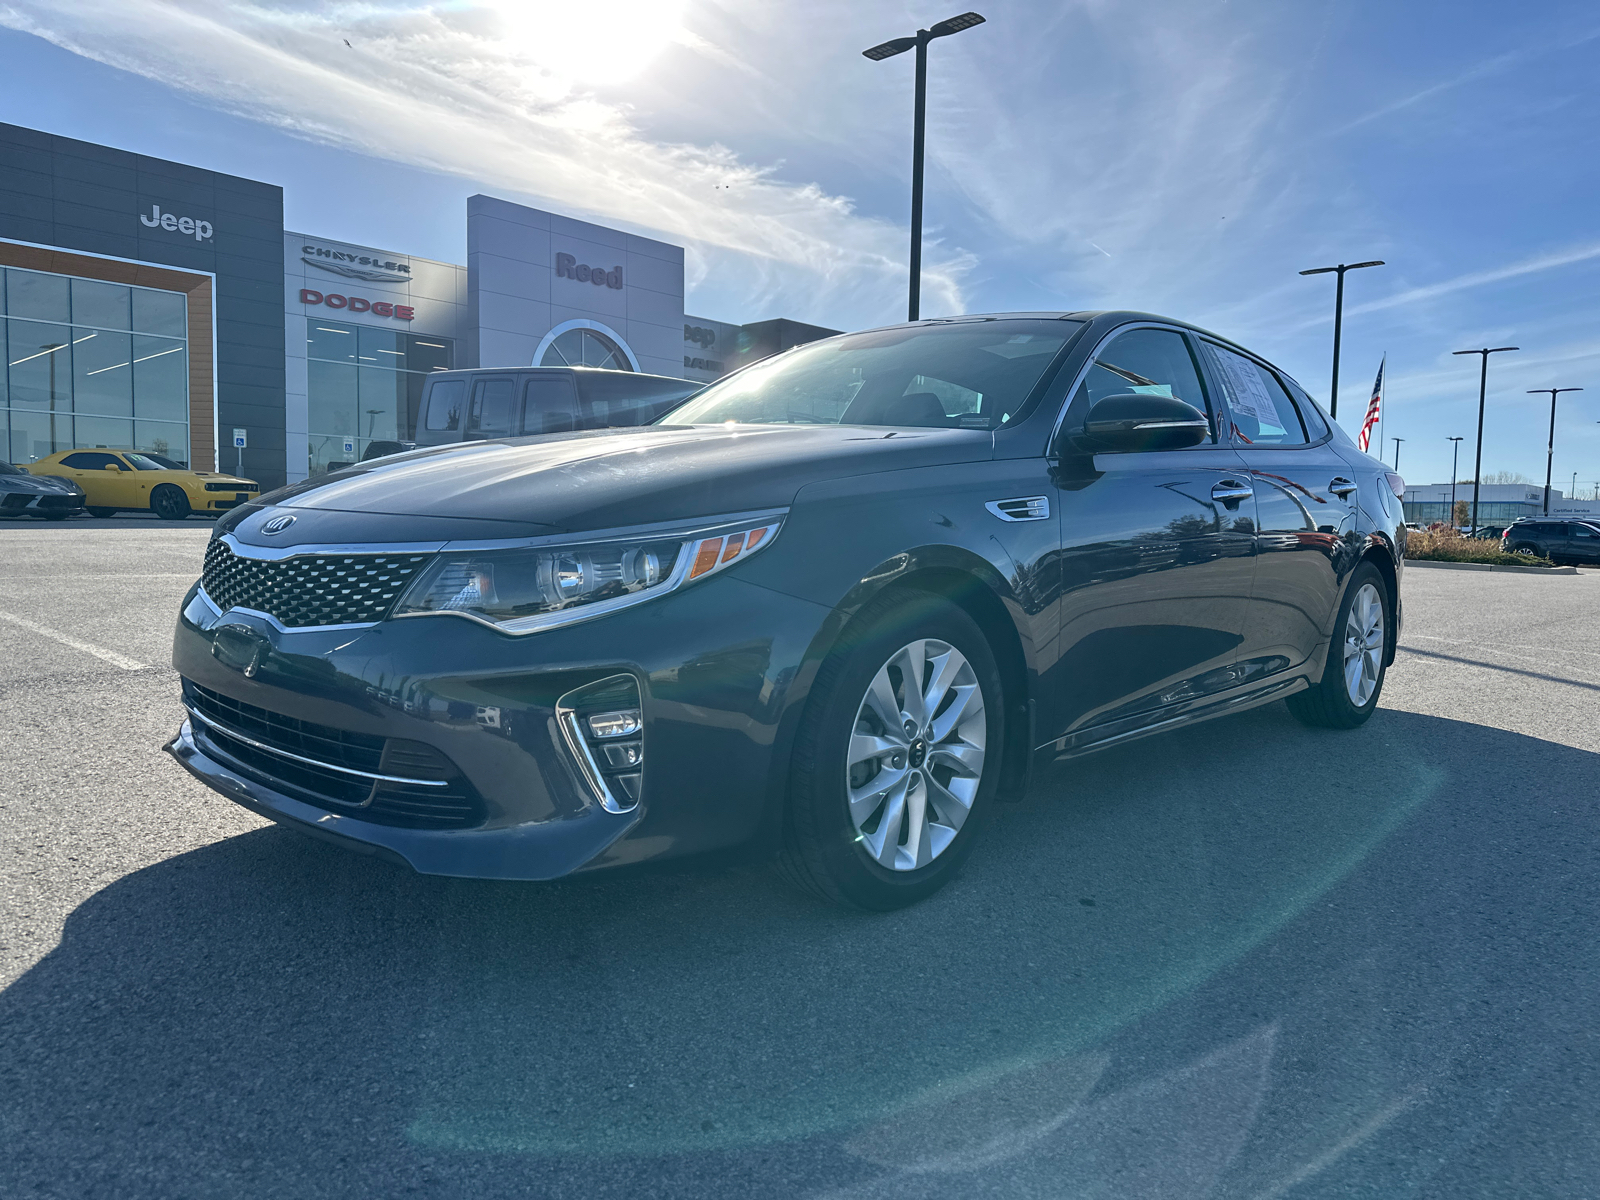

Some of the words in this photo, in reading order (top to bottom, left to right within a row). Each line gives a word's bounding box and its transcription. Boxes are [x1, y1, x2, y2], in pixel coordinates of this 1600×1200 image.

[140, 204, 213, 241] Jeep
[302, 245, 411, 273] CHRYSLER
[556, 252, 623, 290] Reed
[300, 288, 415, 320] DODGE
